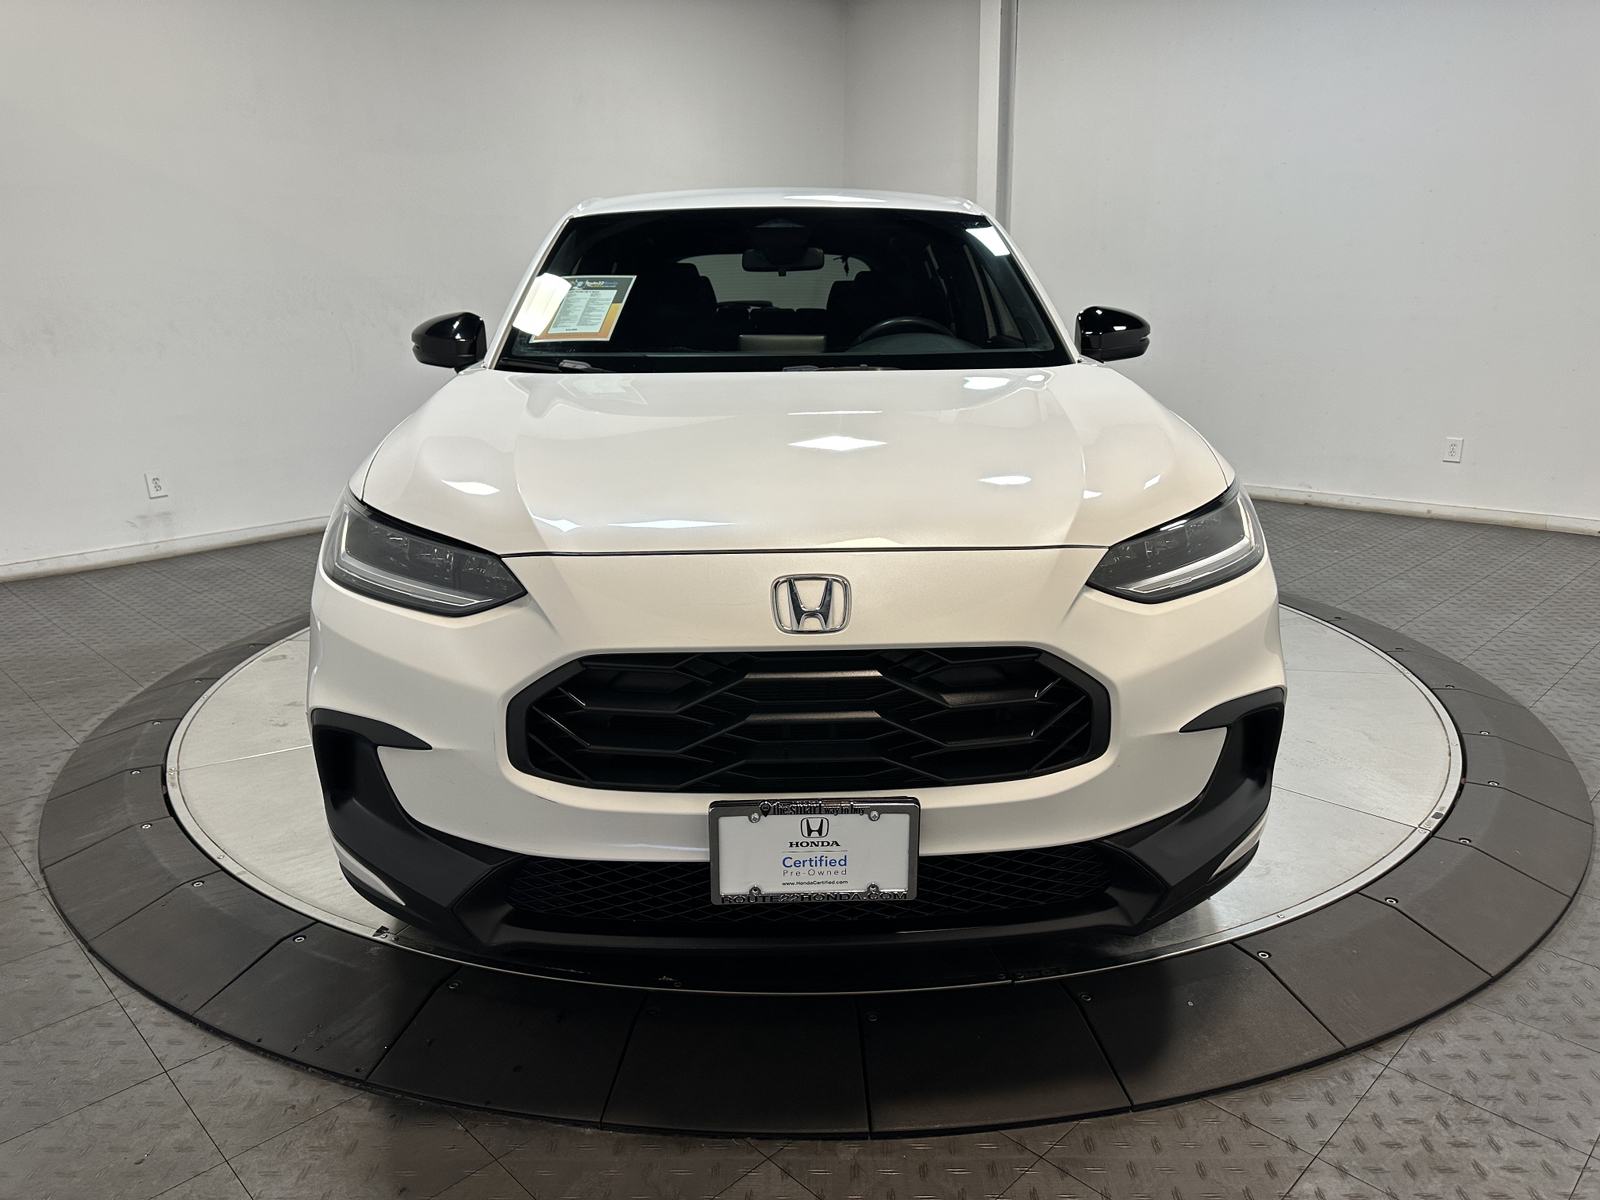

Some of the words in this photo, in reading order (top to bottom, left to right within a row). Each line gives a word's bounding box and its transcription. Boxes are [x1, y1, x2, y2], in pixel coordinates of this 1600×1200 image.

[774, 802, 788, 815] the
[790, 802, 822, 815] smart
[824, 806, 840, 816] way
[841, 803, 849, 815] to
[850, 802, 866, 816] buy
[782, 855, 848, 868] Certified
[782, 868, 847, 877] Pre-Owned
[720, 892, 907, 904] ROUTE22HONDA.COM
